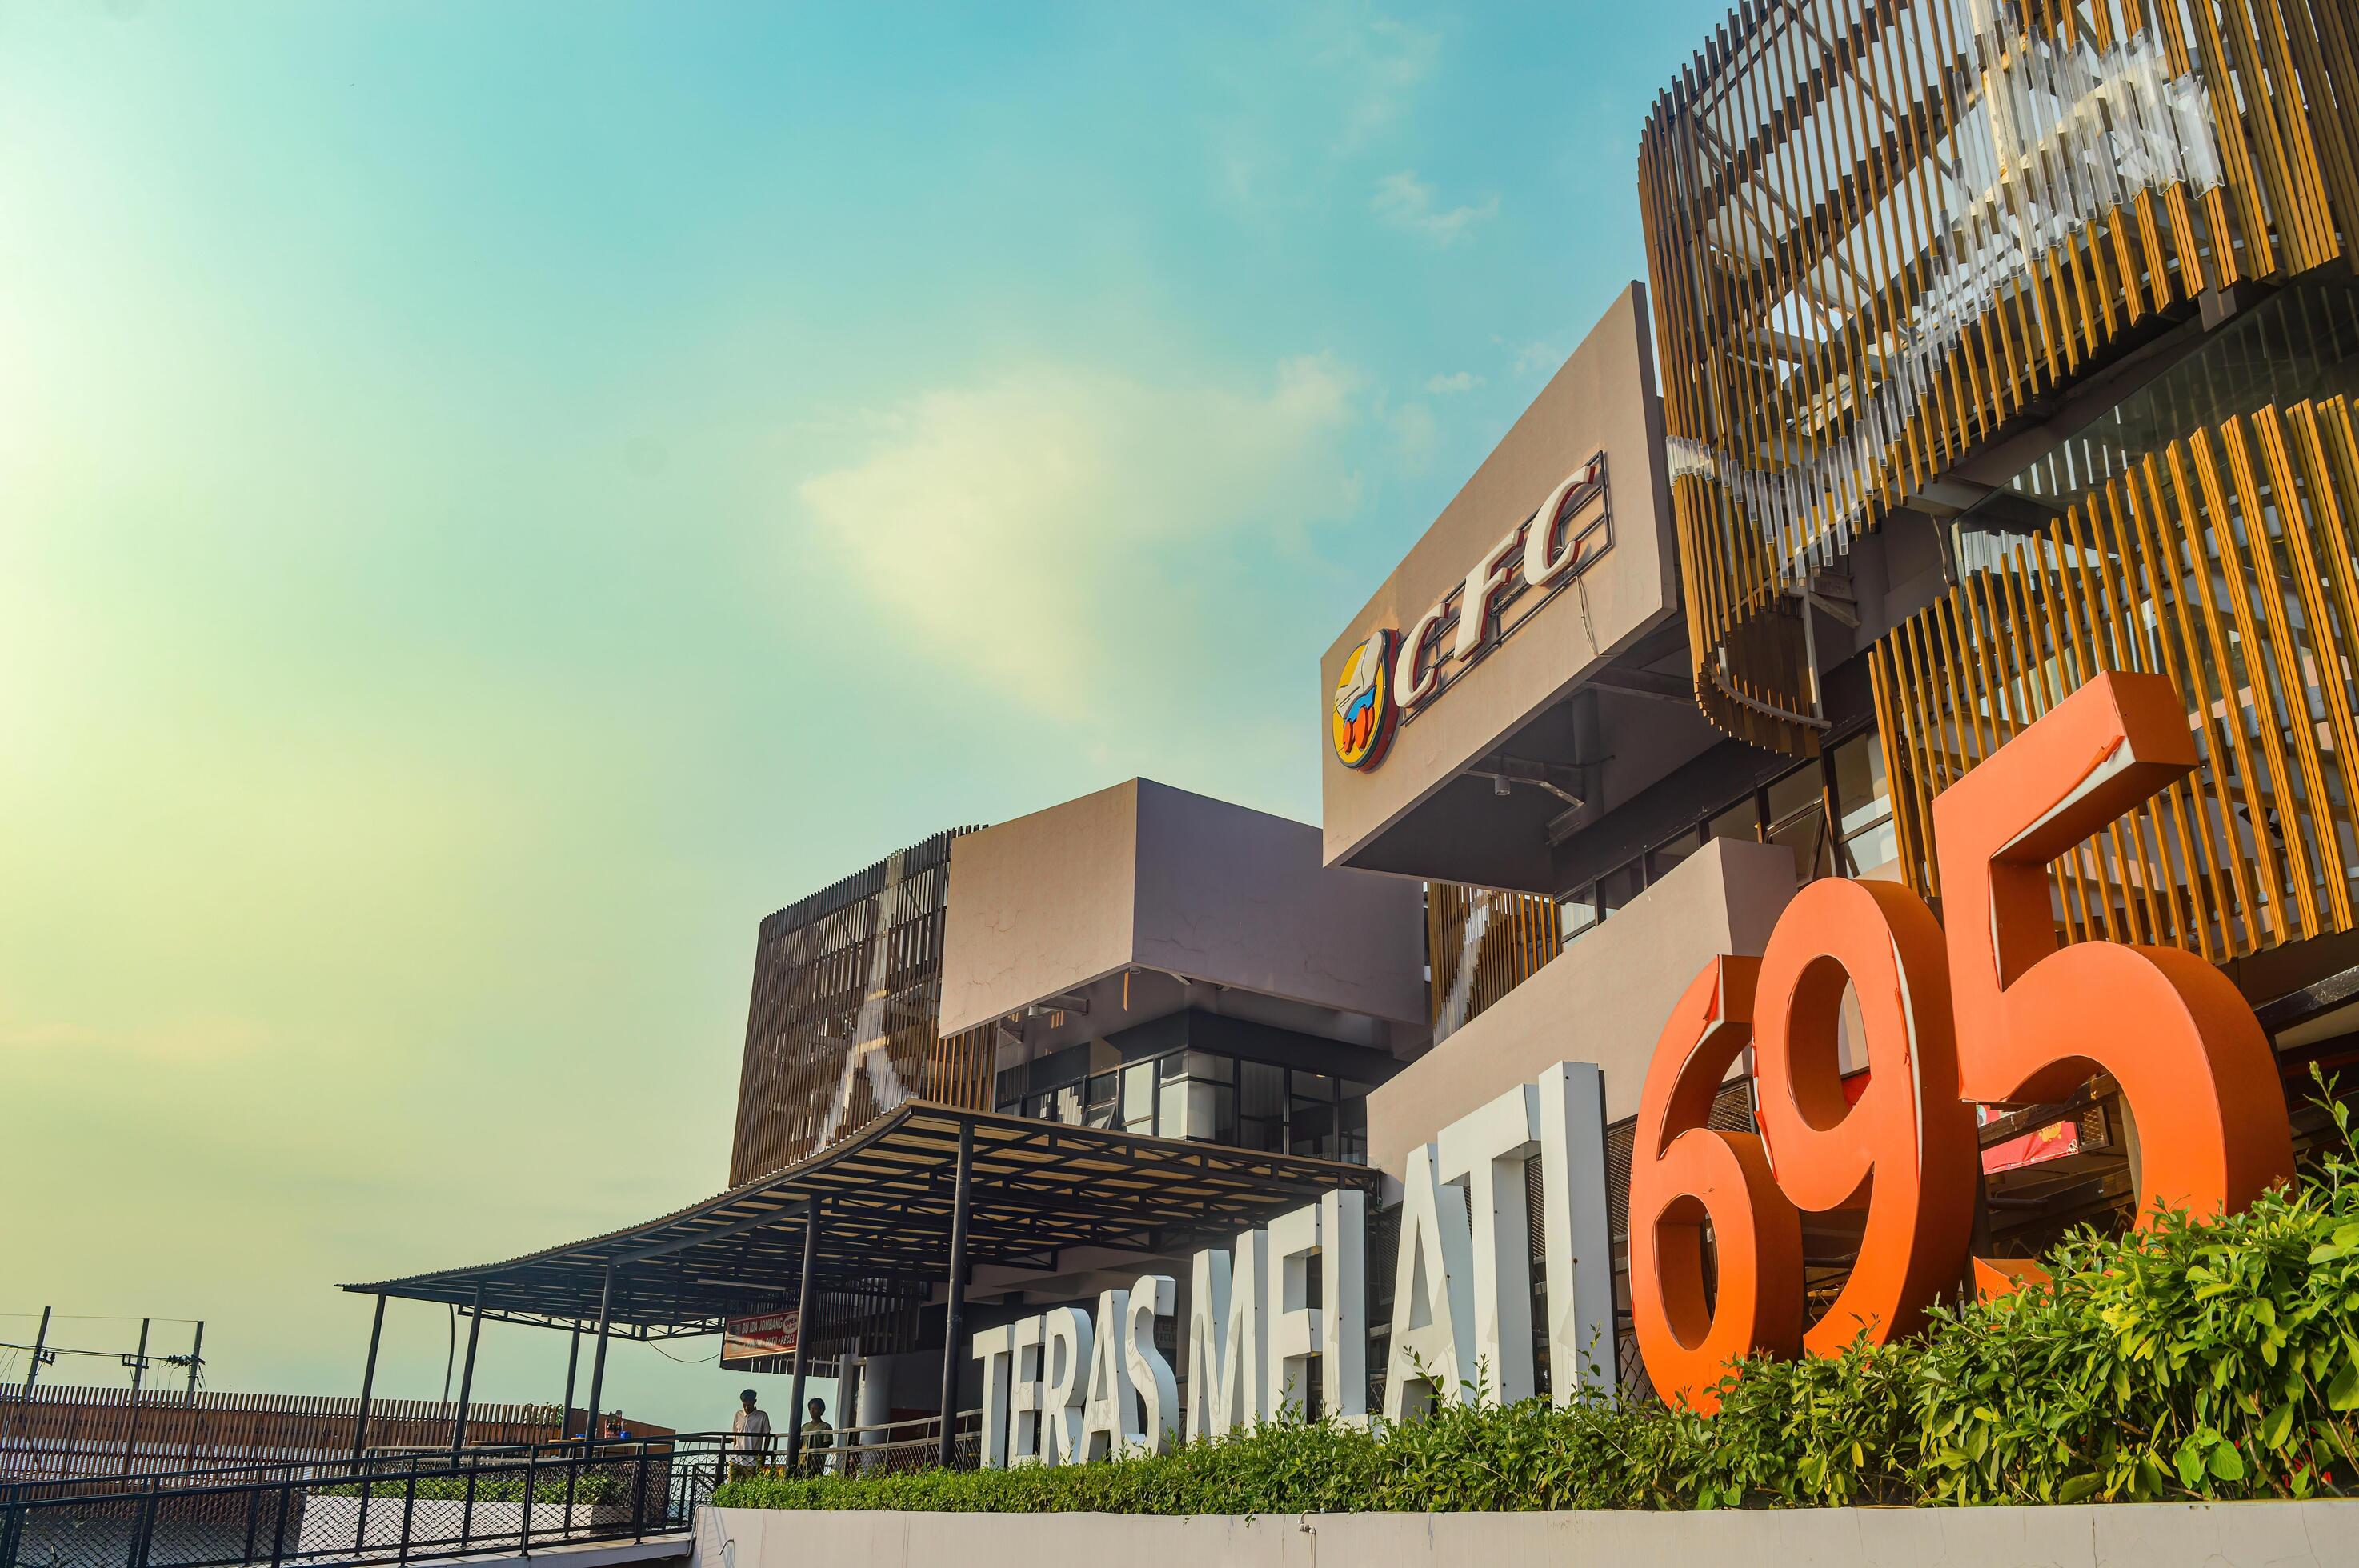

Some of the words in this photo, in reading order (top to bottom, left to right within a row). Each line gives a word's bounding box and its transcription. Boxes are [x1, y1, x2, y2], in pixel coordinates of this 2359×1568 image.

[1394, 466, 1596, 708] CFC
[973, 1275, 1179, 1470] TERAS
[1185, 1060, 1619, 1452] MELATI
[1629, 670, 2296, 1418] 695
[758, 1317, 783, 1332] JOMBANG
